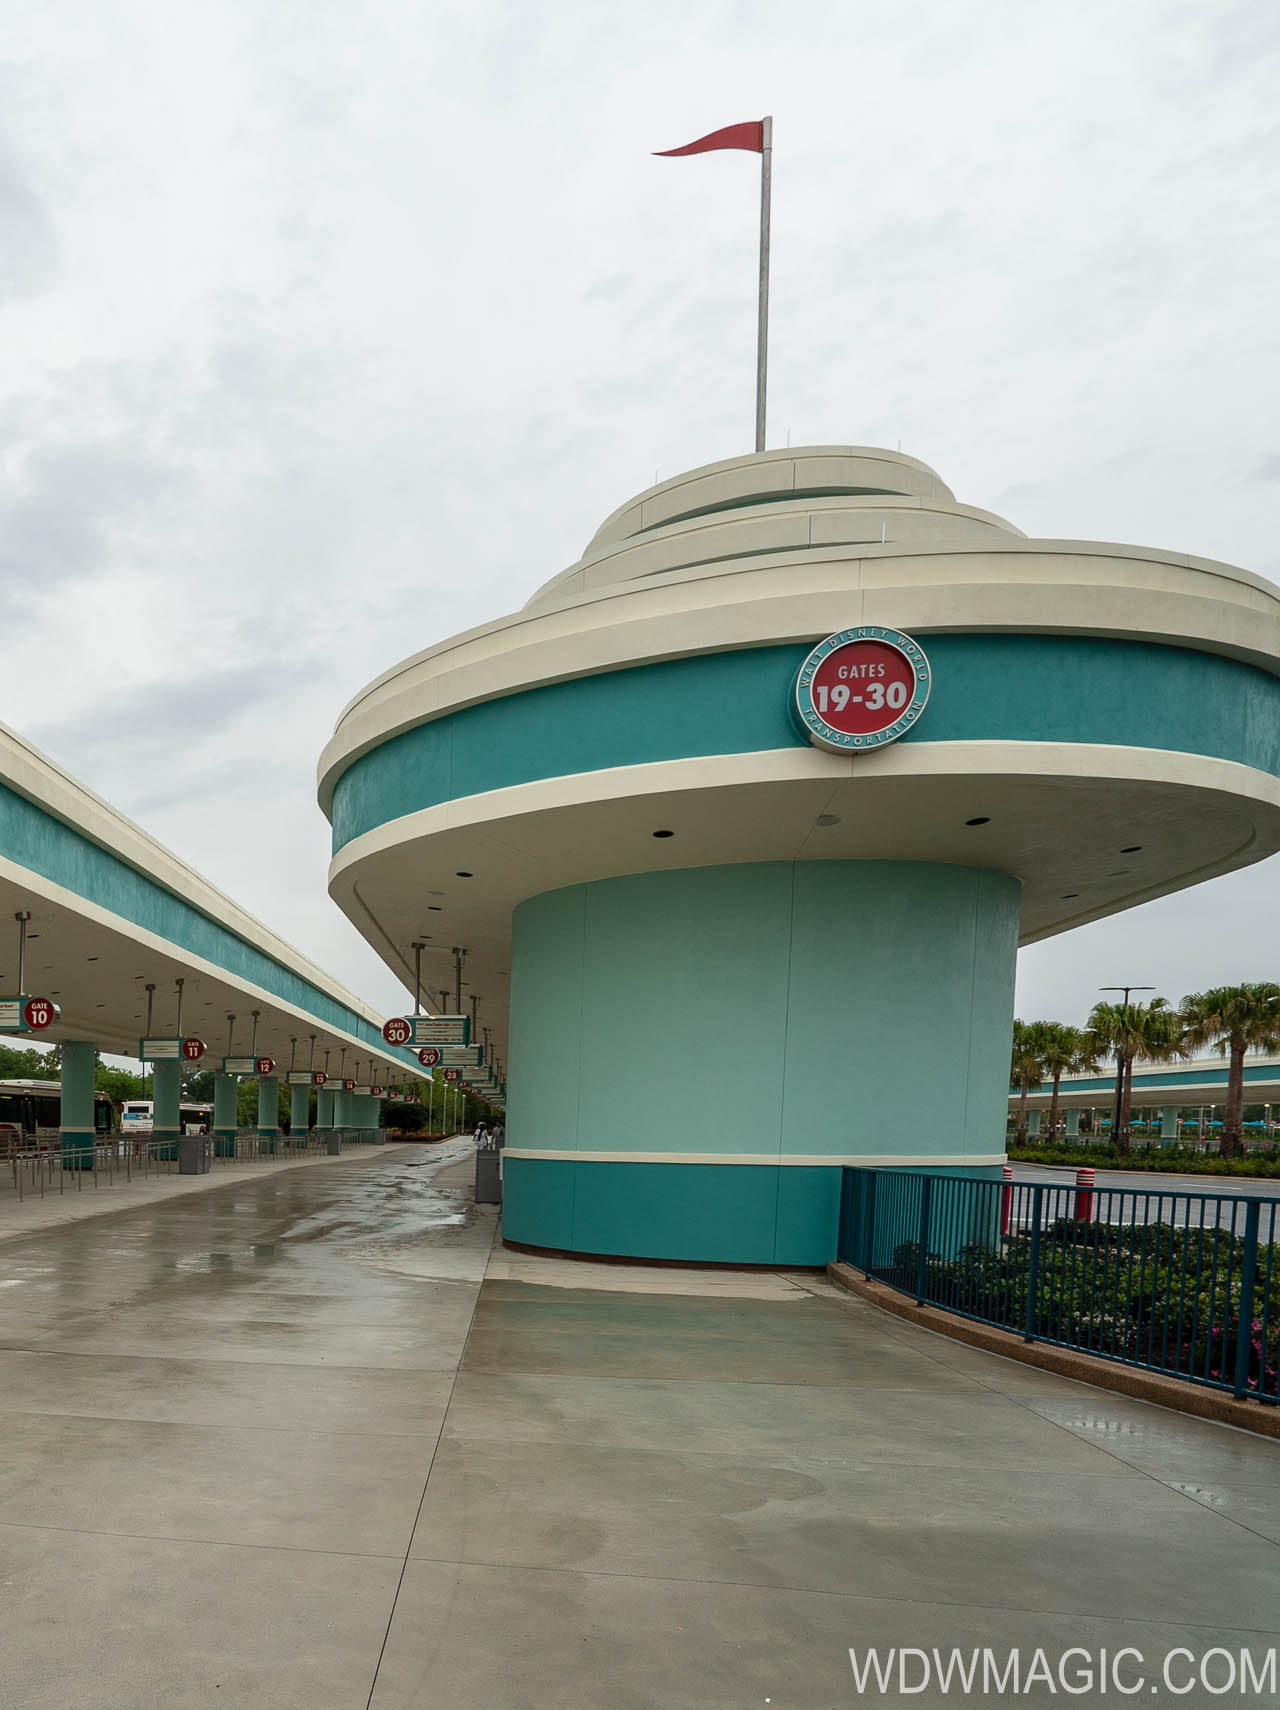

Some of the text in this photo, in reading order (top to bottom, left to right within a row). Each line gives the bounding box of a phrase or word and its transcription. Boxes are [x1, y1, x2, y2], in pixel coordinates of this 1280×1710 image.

[801, 628, 928, 688] WALT DISNEY WORLD
[838, 664, 886, 680] GATES
[816, 682, 907, 712] 19-30
[803, 700, 922, 746] TRANSPORTATION
[31, 1011, 48, 1024] 10
[388, 1029, 405, 1041] 30
[188, 1047, 198, 1057] 11
[422, 1054, 435, 1064] 29
[260, 1064, 270, 1073] 12
[447, 1072, 457, 1080] 28
